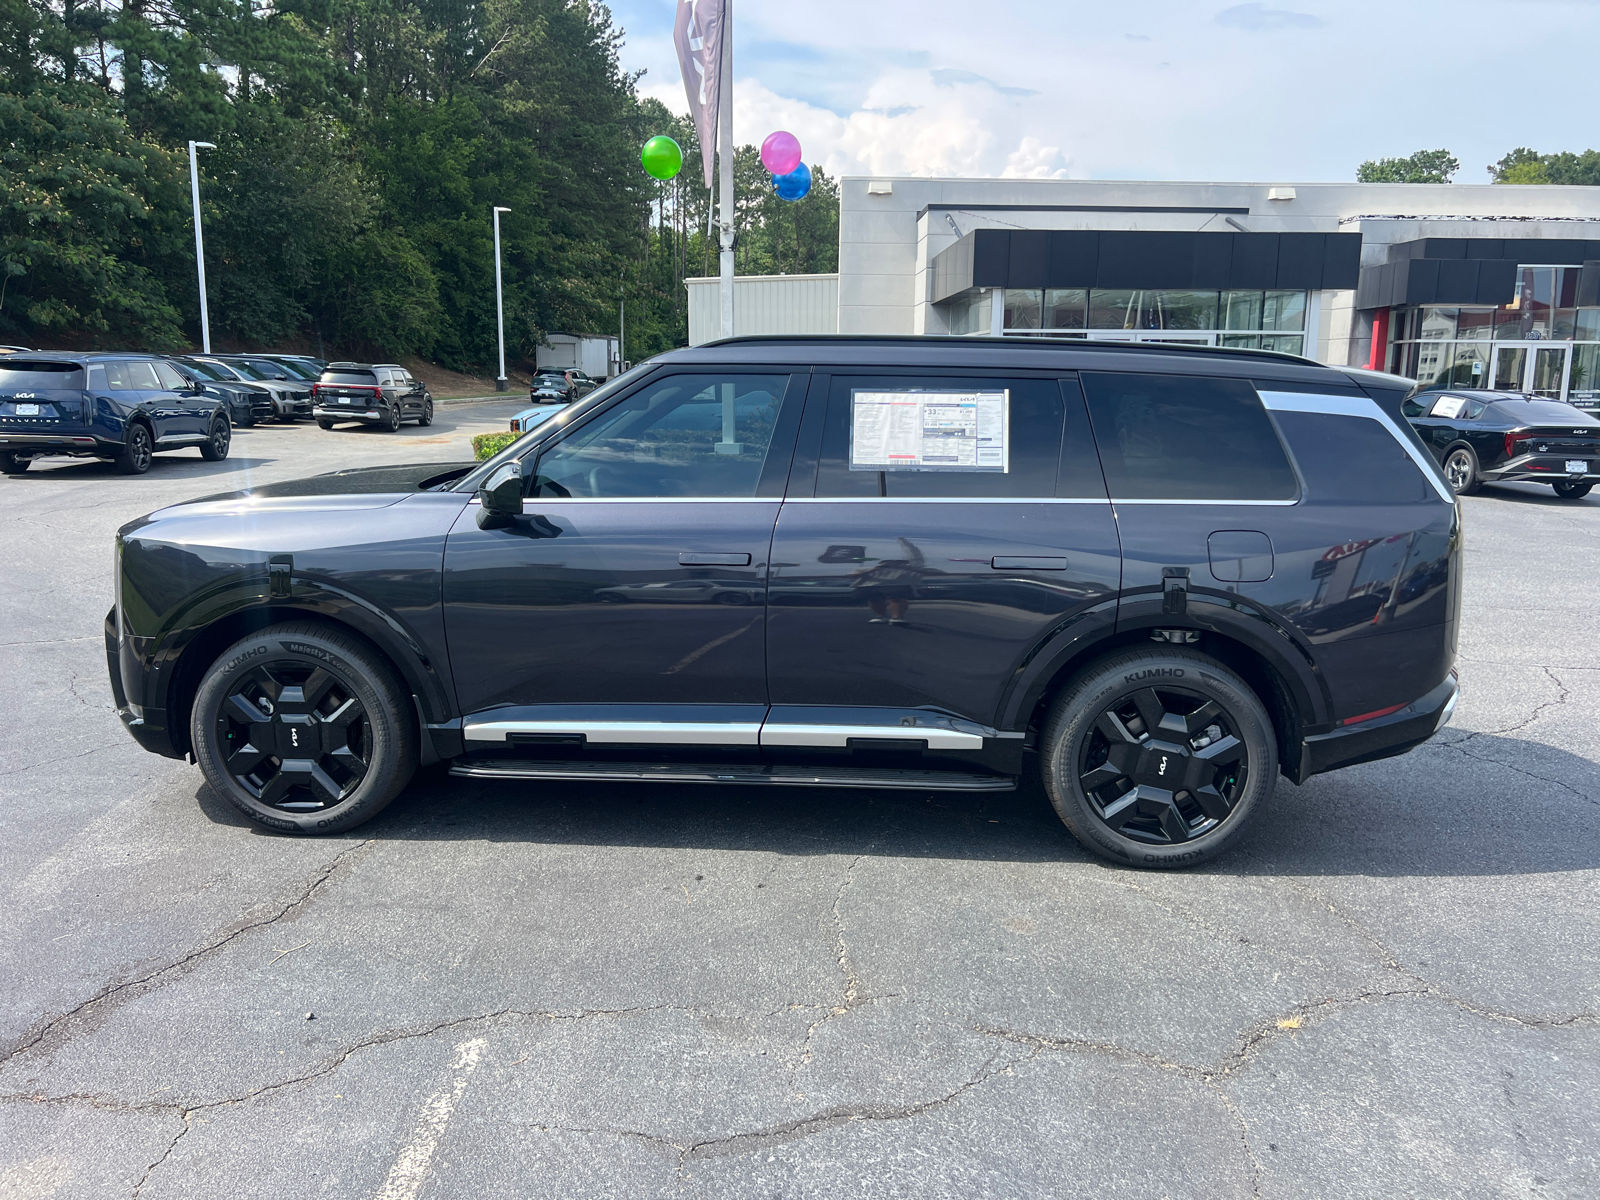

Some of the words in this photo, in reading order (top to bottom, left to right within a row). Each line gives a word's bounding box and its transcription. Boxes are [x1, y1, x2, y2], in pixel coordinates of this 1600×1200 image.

[220, 645, 268, 676] KUMHO
[1124, 668, 1186, 684] KUMHO
[1100, 685, 1113, 698] R20
[316, 798, 367, 829] KUMHO
[1143, 848, 1204, 863] KUMHO
